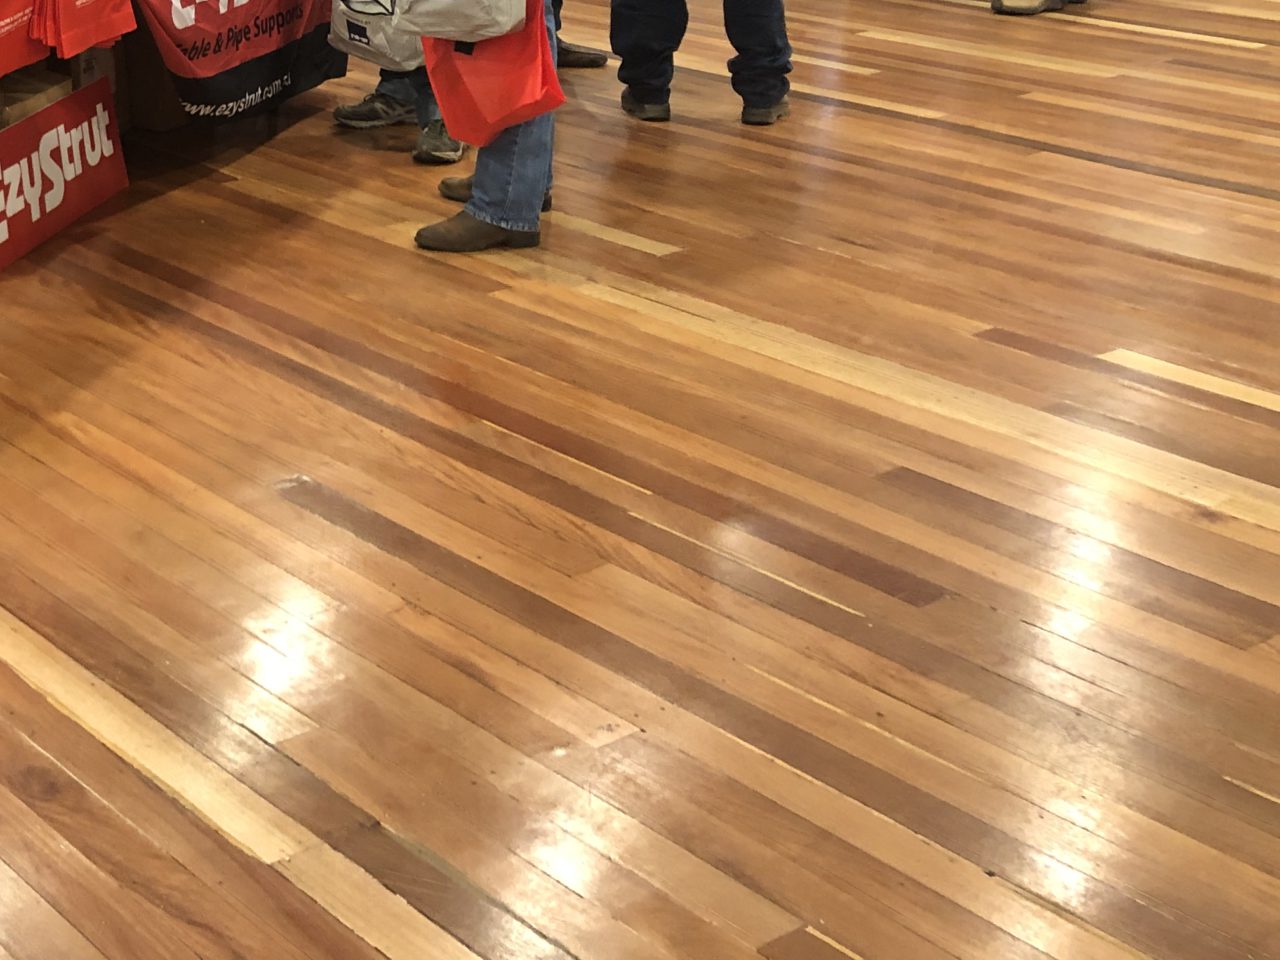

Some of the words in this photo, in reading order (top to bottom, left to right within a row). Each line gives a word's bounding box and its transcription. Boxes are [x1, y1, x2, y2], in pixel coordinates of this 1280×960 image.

[212, 33, 223, 54] &
[225, 27, 251, 51] Pipe
[253, 5, 304, 37] Supports
